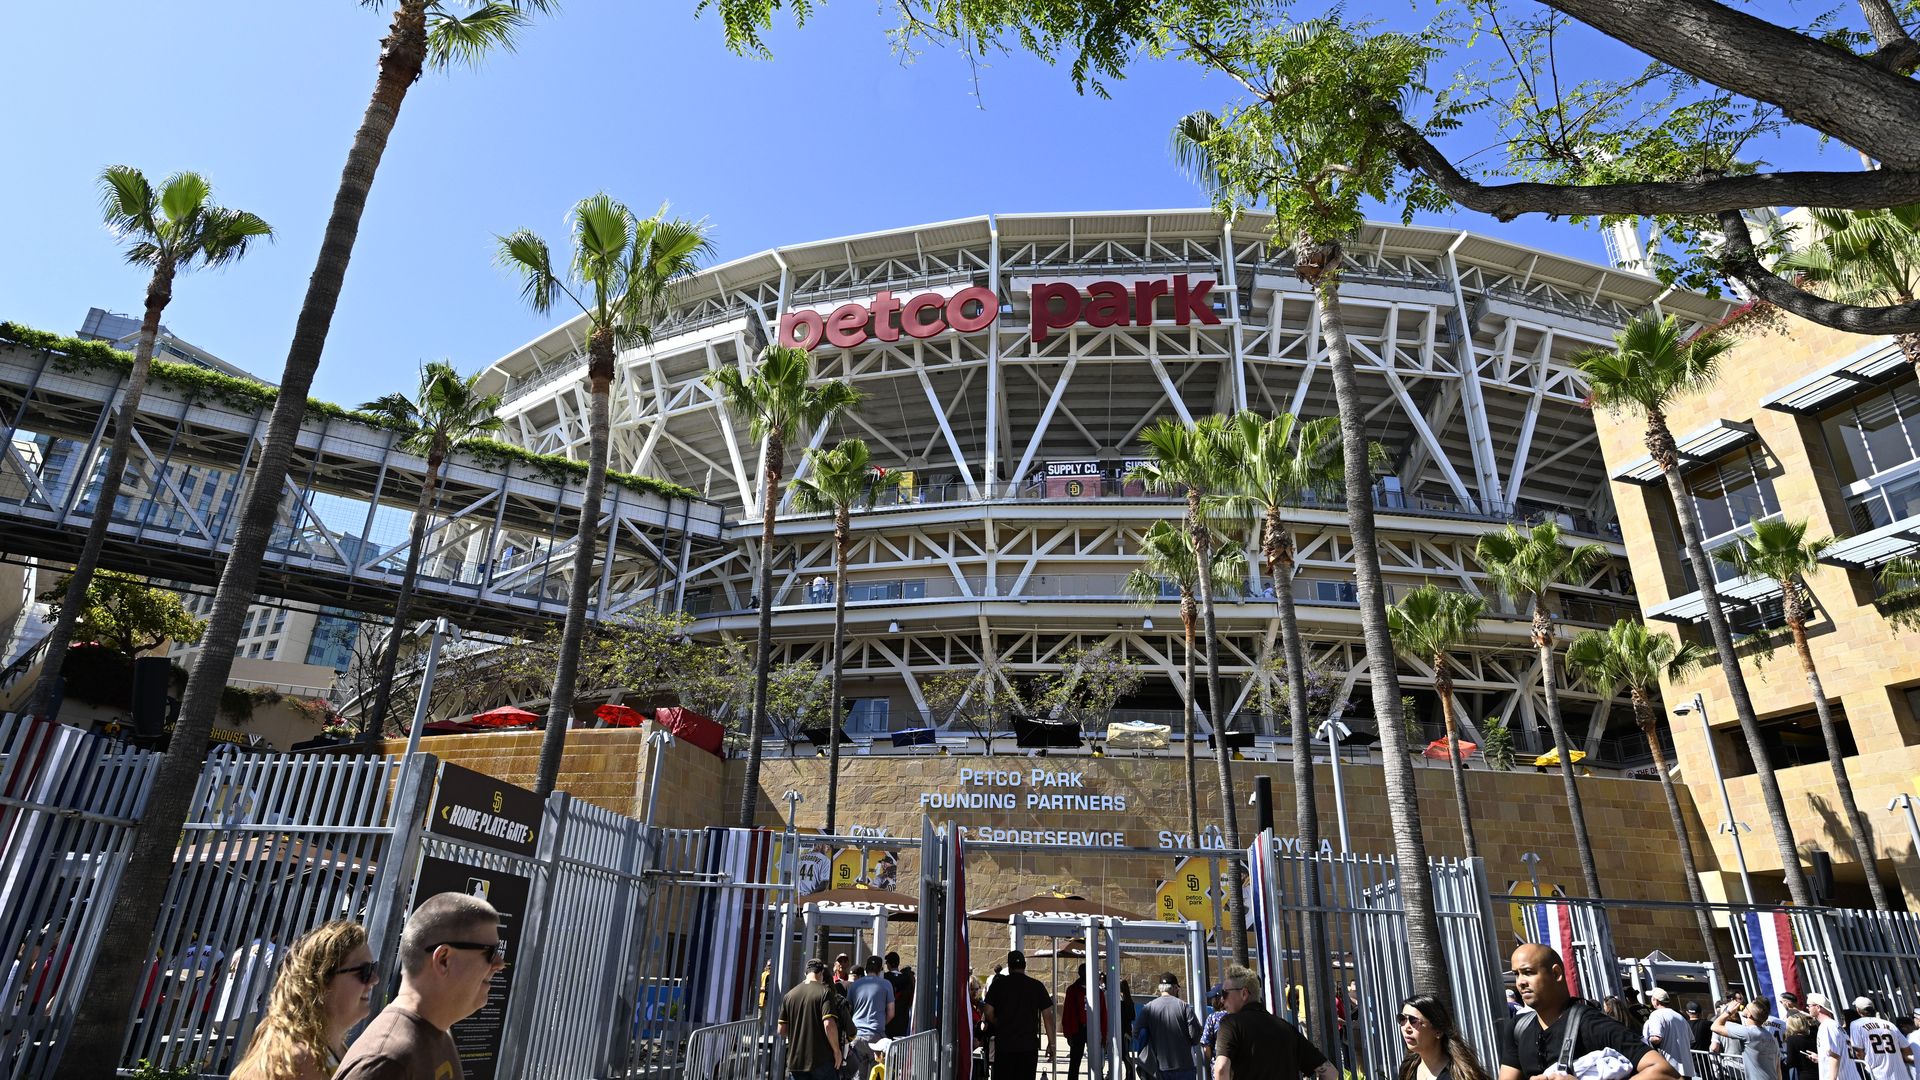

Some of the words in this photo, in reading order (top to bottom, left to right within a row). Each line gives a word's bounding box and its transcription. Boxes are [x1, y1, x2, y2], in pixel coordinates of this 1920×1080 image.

[778, 286, 999, 352] petco
[1031, 274, 1222, 343] park
[1048, 463, 1082, 475] SUPPLY
[1084, 463, 1100, 474] CO.
[960, 768, 1021, 787] PETCO
[1031, 768, 1083, 788] PARK
[920, 792, 1016, 809] FOUNDING
[1027, 794, 1126, 812] PARTNERS
[449, 804, 481, 830] HOME
[478, 812, 509, 838] PLATE
[505, 821, 529, 844] GATE
[1158, 830, 1241, 850] SYUA
[800, 863, 814, 880] 44
[1185, 895, 1203, 903] petco
[1869, 1034, 1897, 1055] 23
